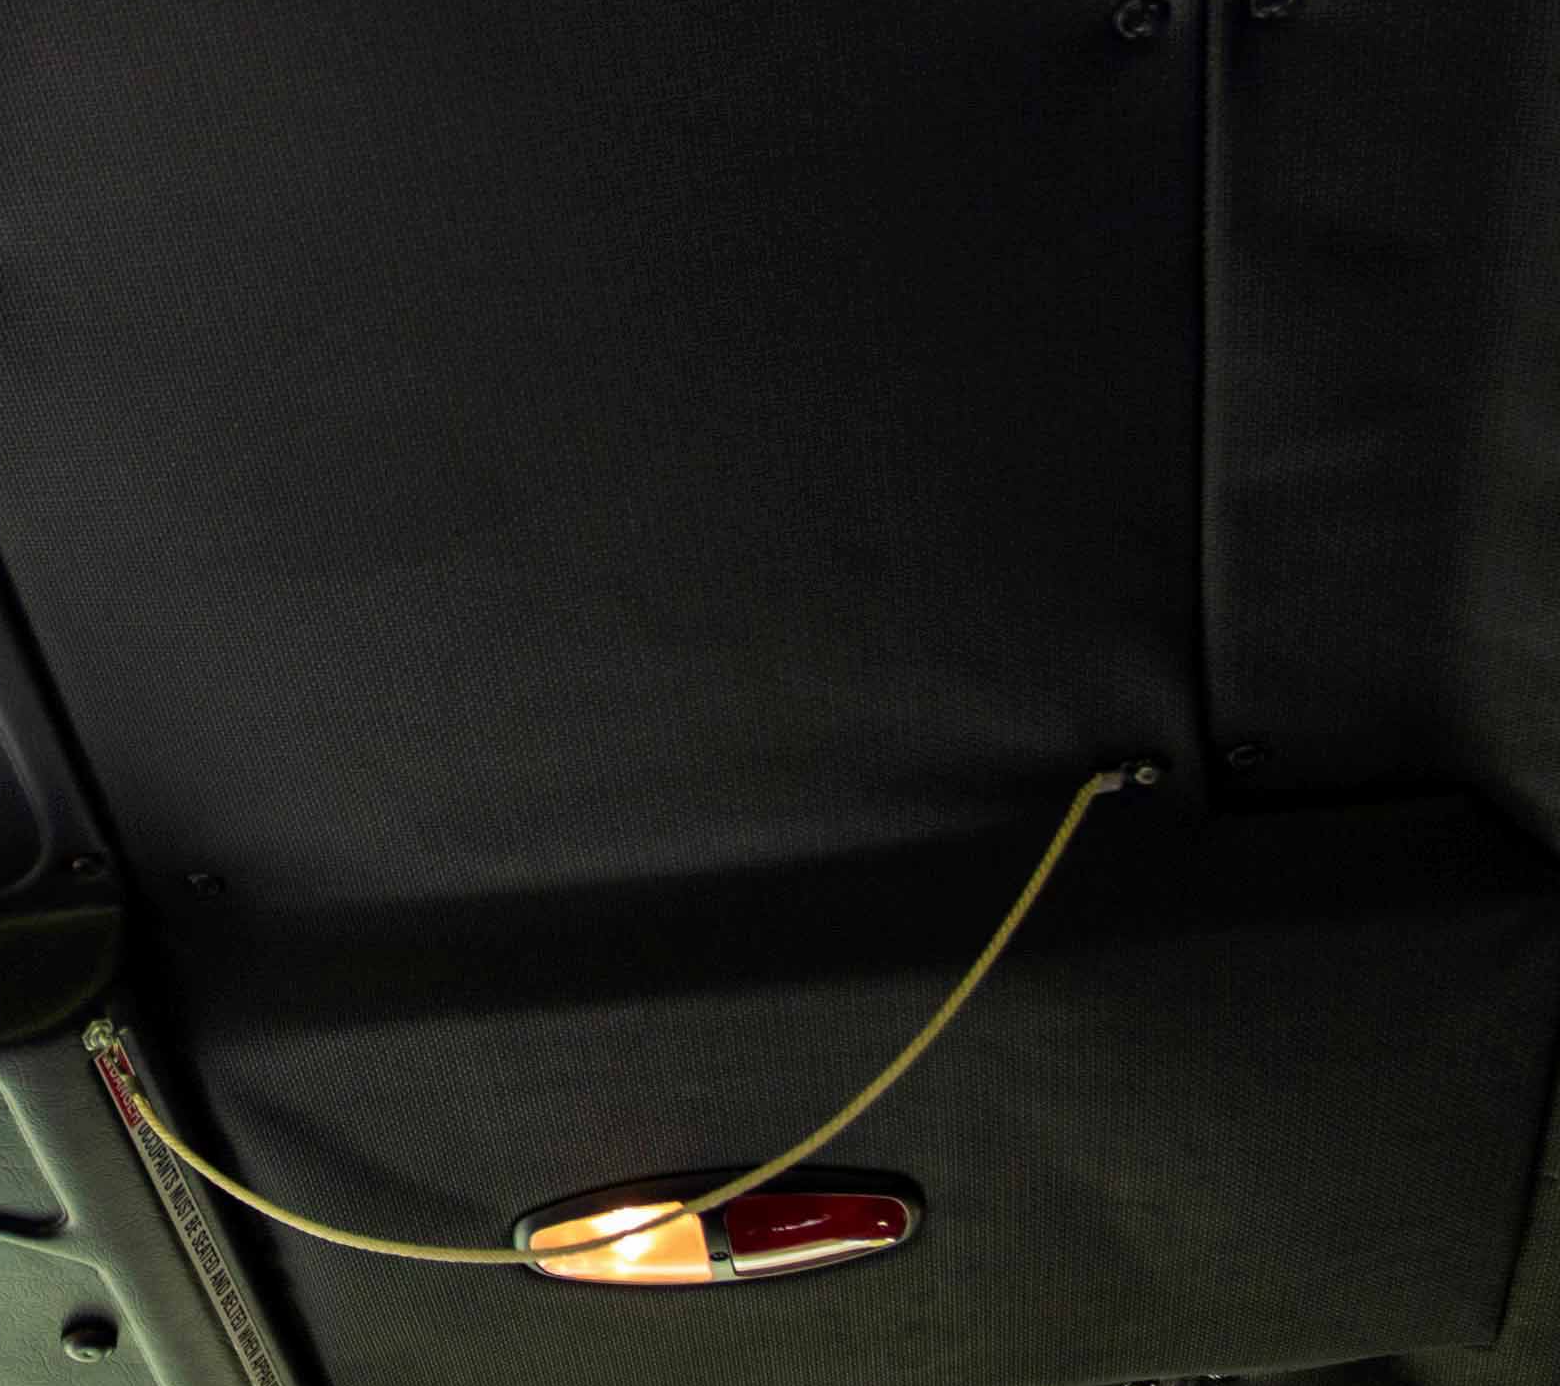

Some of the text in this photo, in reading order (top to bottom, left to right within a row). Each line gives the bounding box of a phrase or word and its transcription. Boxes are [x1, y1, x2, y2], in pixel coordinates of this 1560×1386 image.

[137, 1121, 180, 1192] OCCUPANTS
[169, 1182, 195, 1221] MUST
[184, 1214, 202, 1237] BE
[192, 1230, 220, 1275] SEATED
[210, 1268, 231, 1296] AND
[220, 1291, 247, 1332] BELTED
